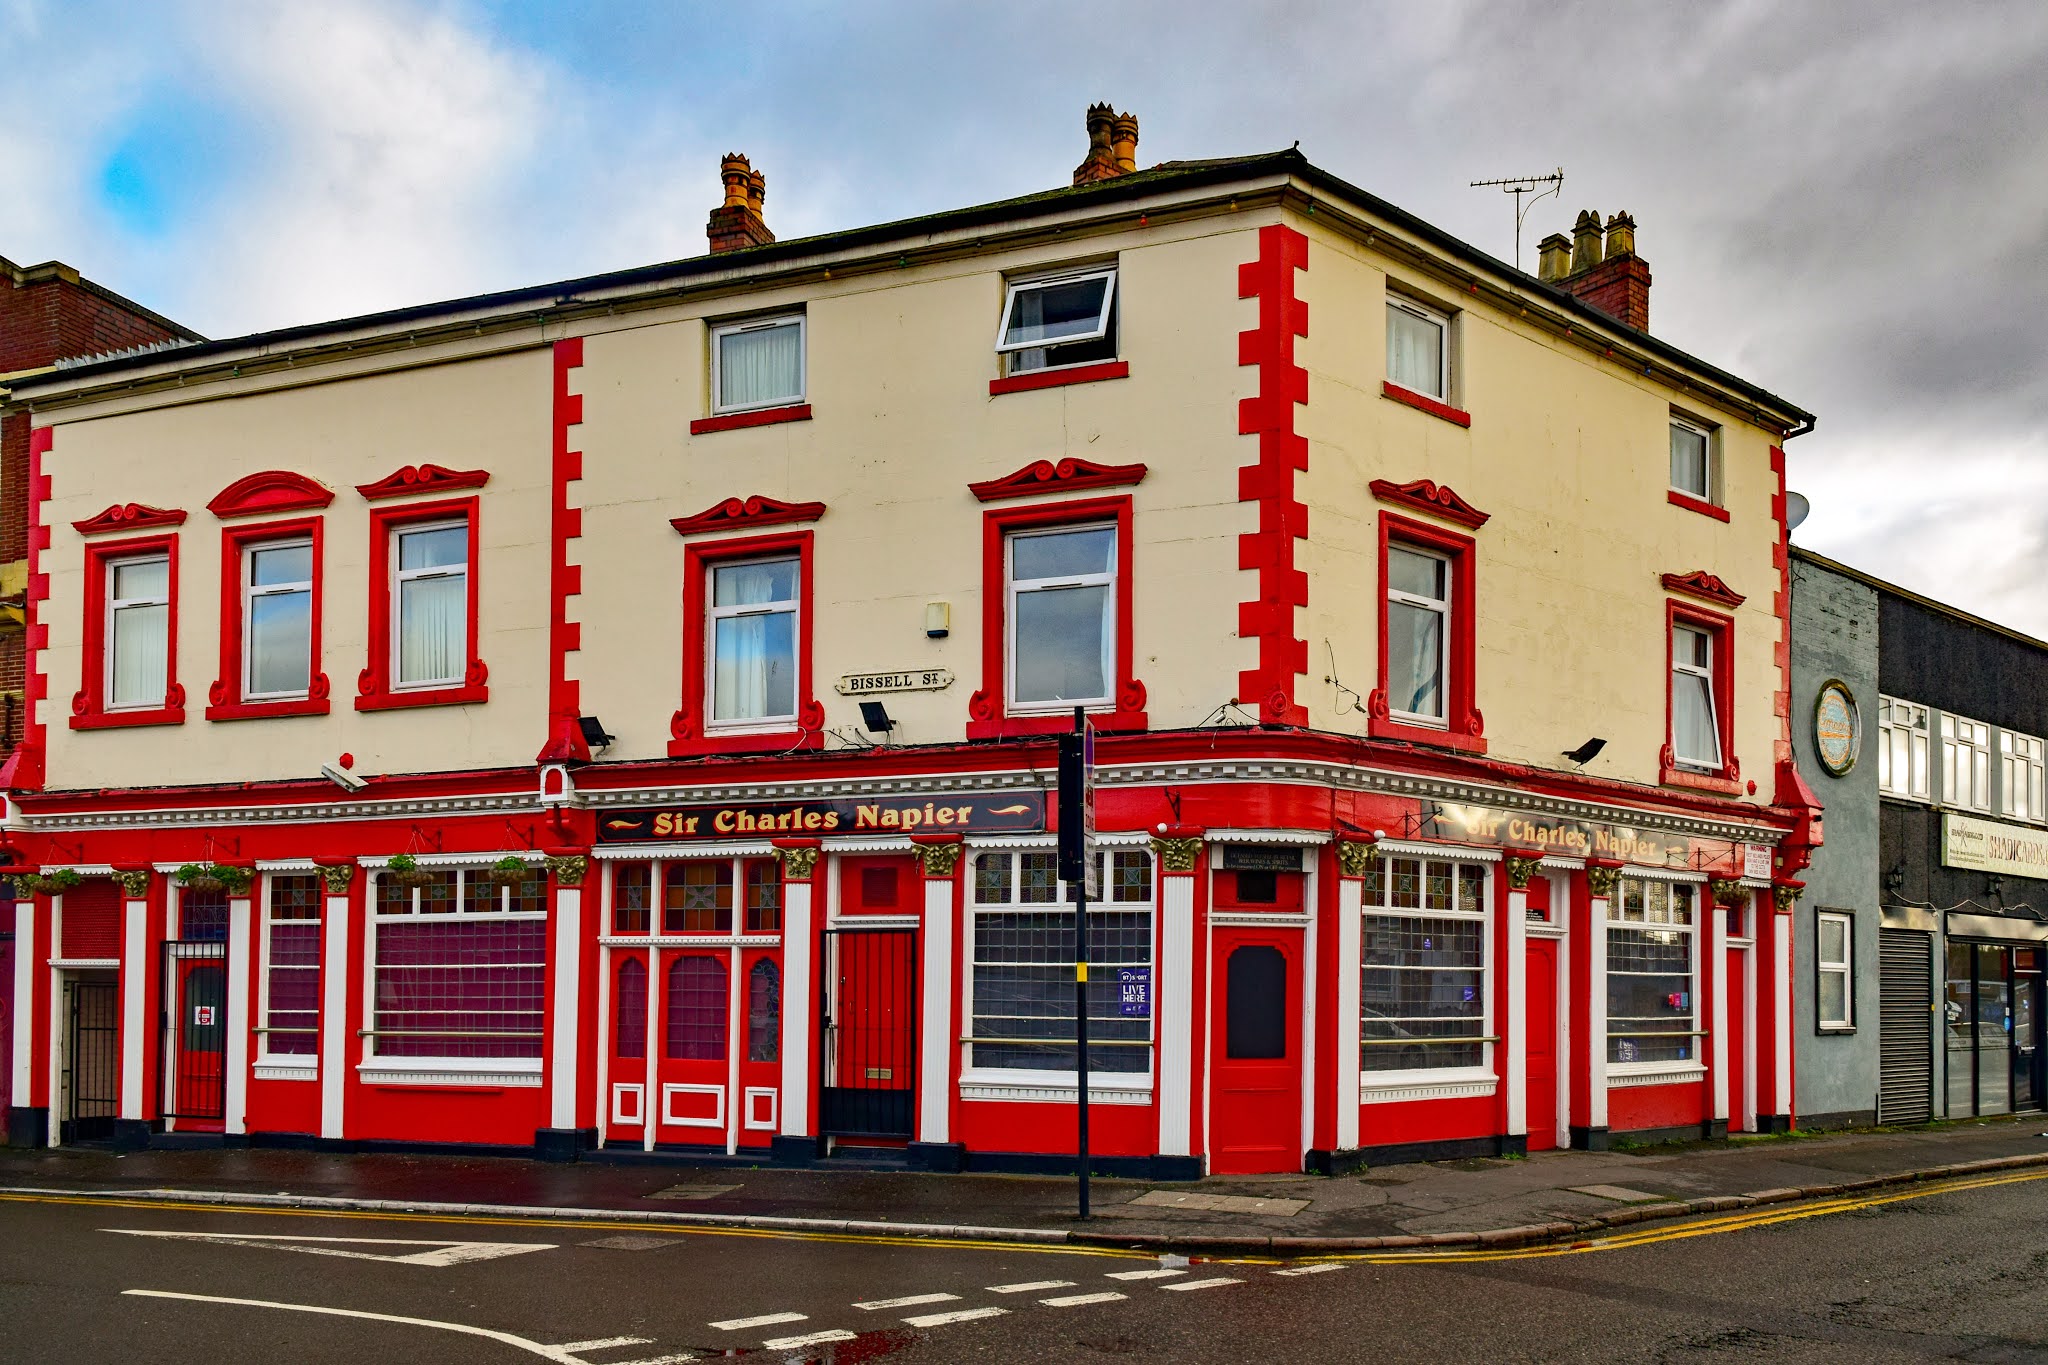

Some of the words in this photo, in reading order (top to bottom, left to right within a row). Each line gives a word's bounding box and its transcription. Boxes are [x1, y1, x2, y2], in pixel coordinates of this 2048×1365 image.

[850, 675, 913, 691] BISSELL
[652, 813, 699, 836] Sir
[713, 807, 840, 834] Charles
[855, 803, 973, 831] Napier
[1465, 814, 1498, 838] Sir
[1508, 819, 1587, 849] Charles
[1595, 830, 1657, 857] Napier
[1122, 984, 1146, 995] LIVE
[1122, 994, 1146, 1003] HERE
